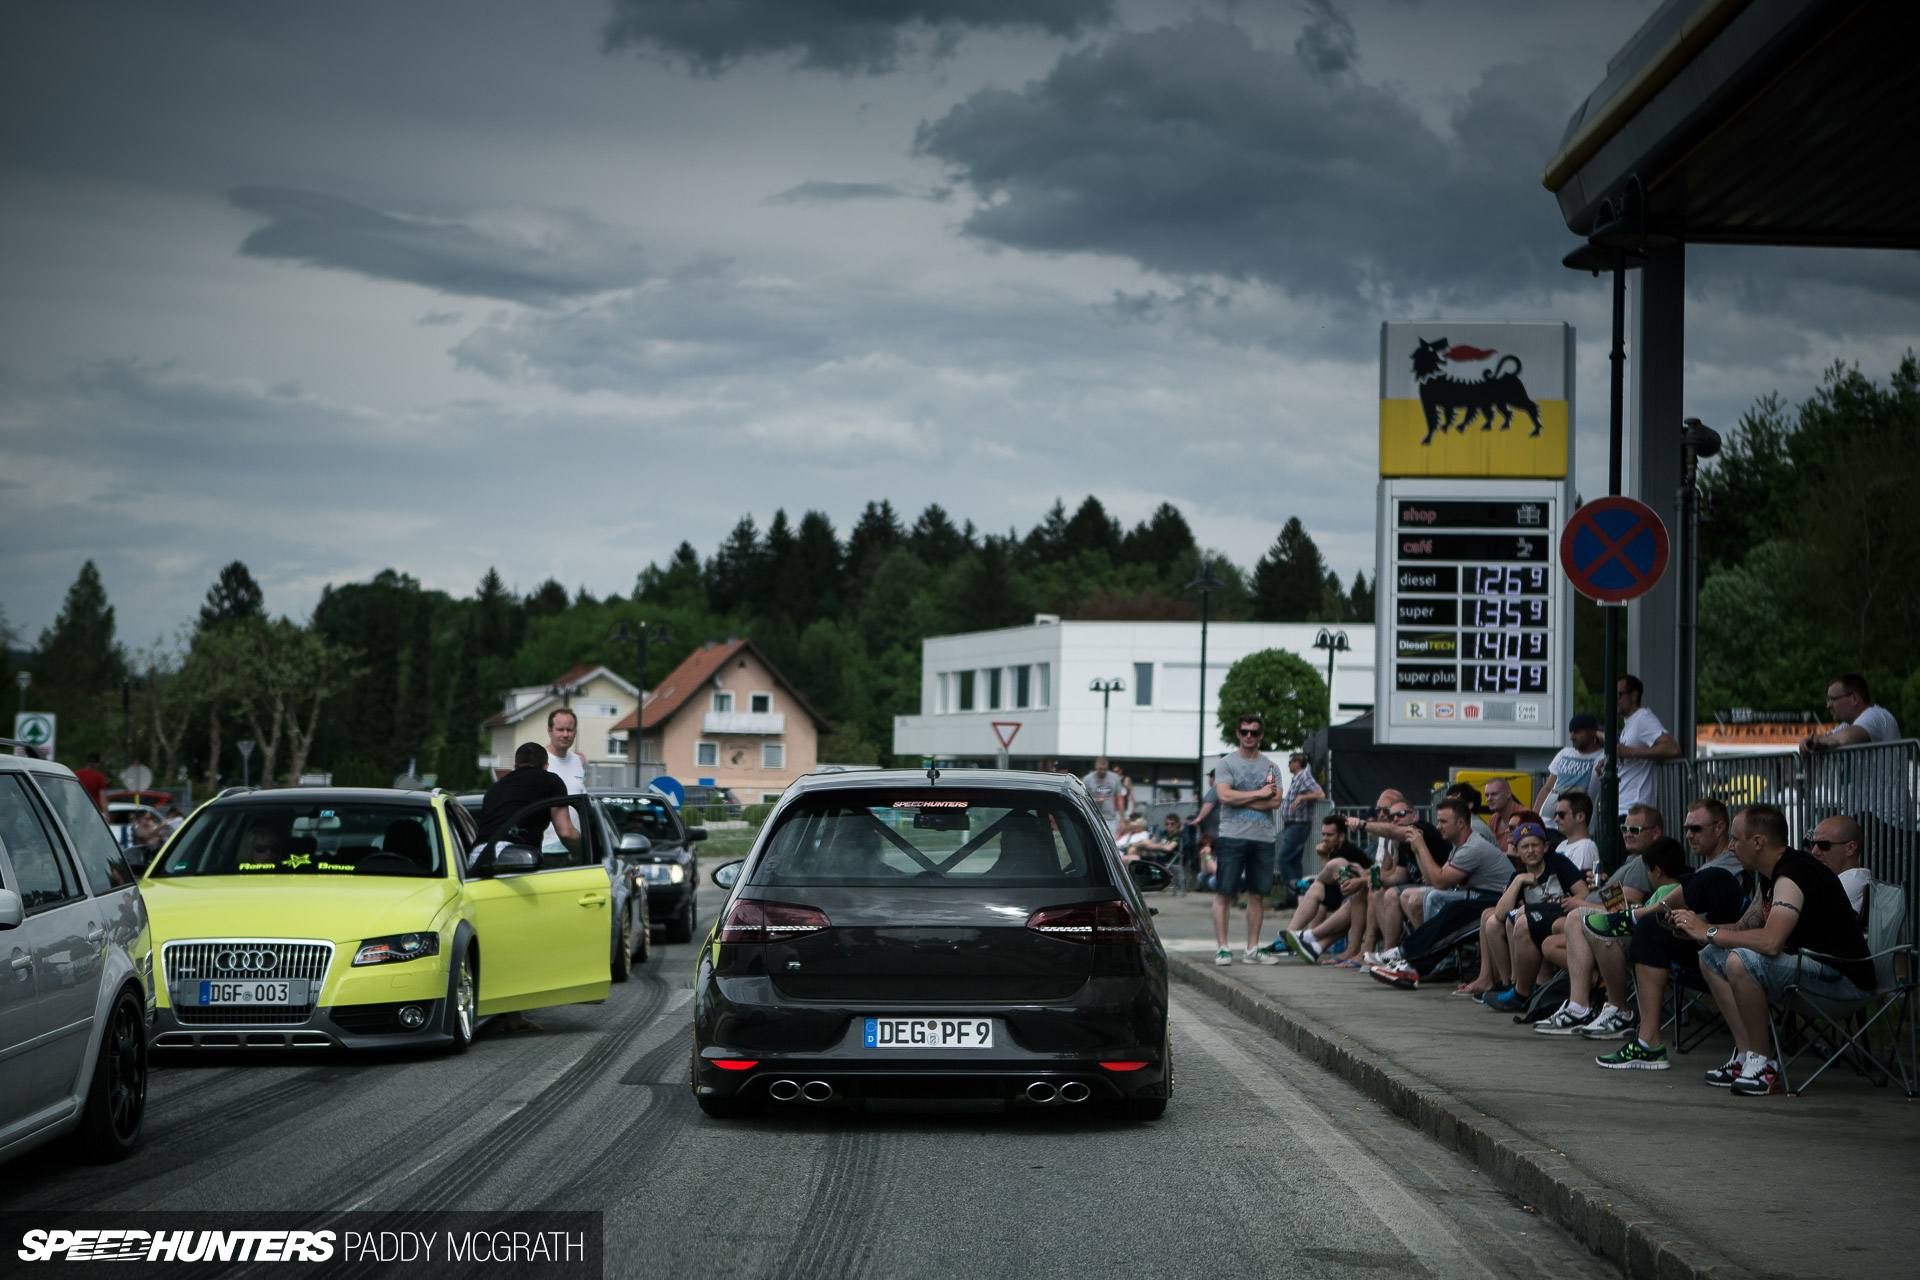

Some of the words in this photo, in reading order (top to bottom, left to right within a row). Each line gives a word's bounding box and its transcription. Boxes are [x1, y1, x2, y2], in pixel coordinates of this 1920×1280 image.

[1403, 508, 1437, 523] shop
[1403, 539, 1433, 553] café
[1400, 573, 1436, 586] diesel
[1399, 606, 1434, 620] super
[1398, 671, 1430, 685] super
[1432, 670, 1456, 685] plus
[211, 984, 243, 1002] DGF
[255, 984, 288, 1002] 003
[879, 1021, 925, 1044] DEG
[941, 1021, 972, 1044] PF
[976, 1021, 990, 1044] 9
